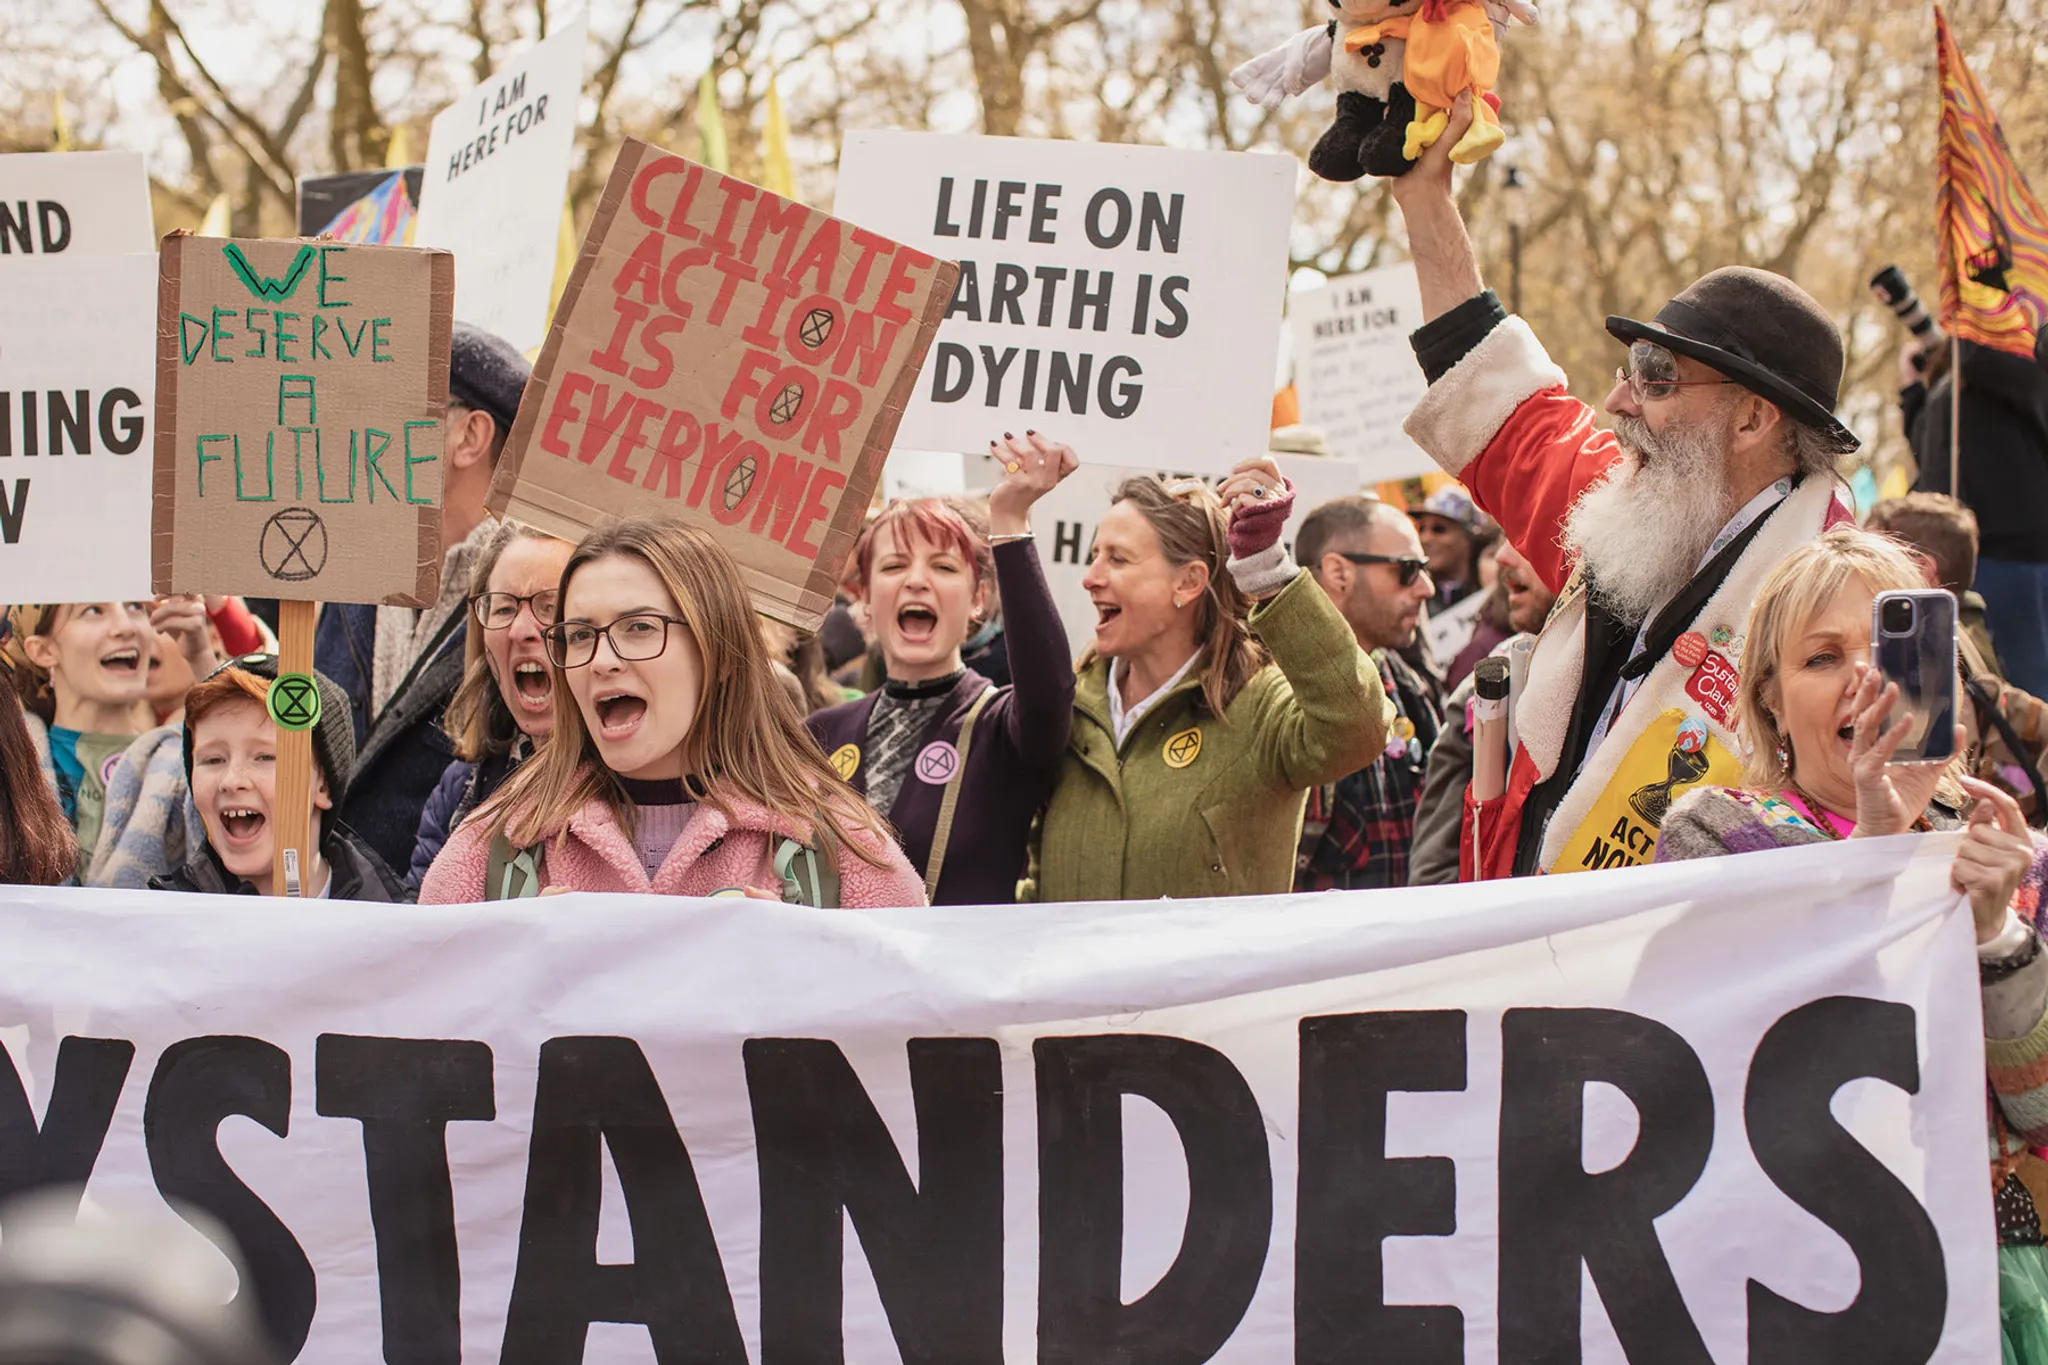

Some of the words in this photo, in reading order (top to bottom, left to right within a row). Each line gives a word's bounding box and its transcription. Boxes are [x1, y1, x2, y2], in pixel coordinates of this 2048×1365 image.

[479, 97, 487, 125] I
[493, 71, 527, 116] AM
[447, 125, 499, 182] HERE
[504, 94, 548, 144] FOR
[630, 156, 935, 327] CLIMATE
[934, 177, 1062, 244] LIFE
[1085, 187, 1185, 253] ON
[222, 243, 351, 308] WE
[612, 230, 902, 388] ACTION
[943, 260, 1113, 332] ARTH
[1131, 274, 1190, 338] IS
[1346, 287, 1373, 306] AM
[180, 305, 394, 365] DESERVE
[1363, 309, 1399, 331] FOR
[279, 375, 317, 426] A
[590, 296, 686, 390] IS
[718, 349, 863, 464] FOR
[931, 342, 1143, 419] DYING
[197, 420, 438, 504] FUTURE
[541, 371, 847, 559] EVERYONE
[1698, 675, 1734, 716] Claus
[1701, 654, 1739, 698] Sustai
[1581, 836, 1643, 871] NO
[1609, 816, 1655, 856] ACT
[0, 996, 1949, 1365] YSTANDERS
